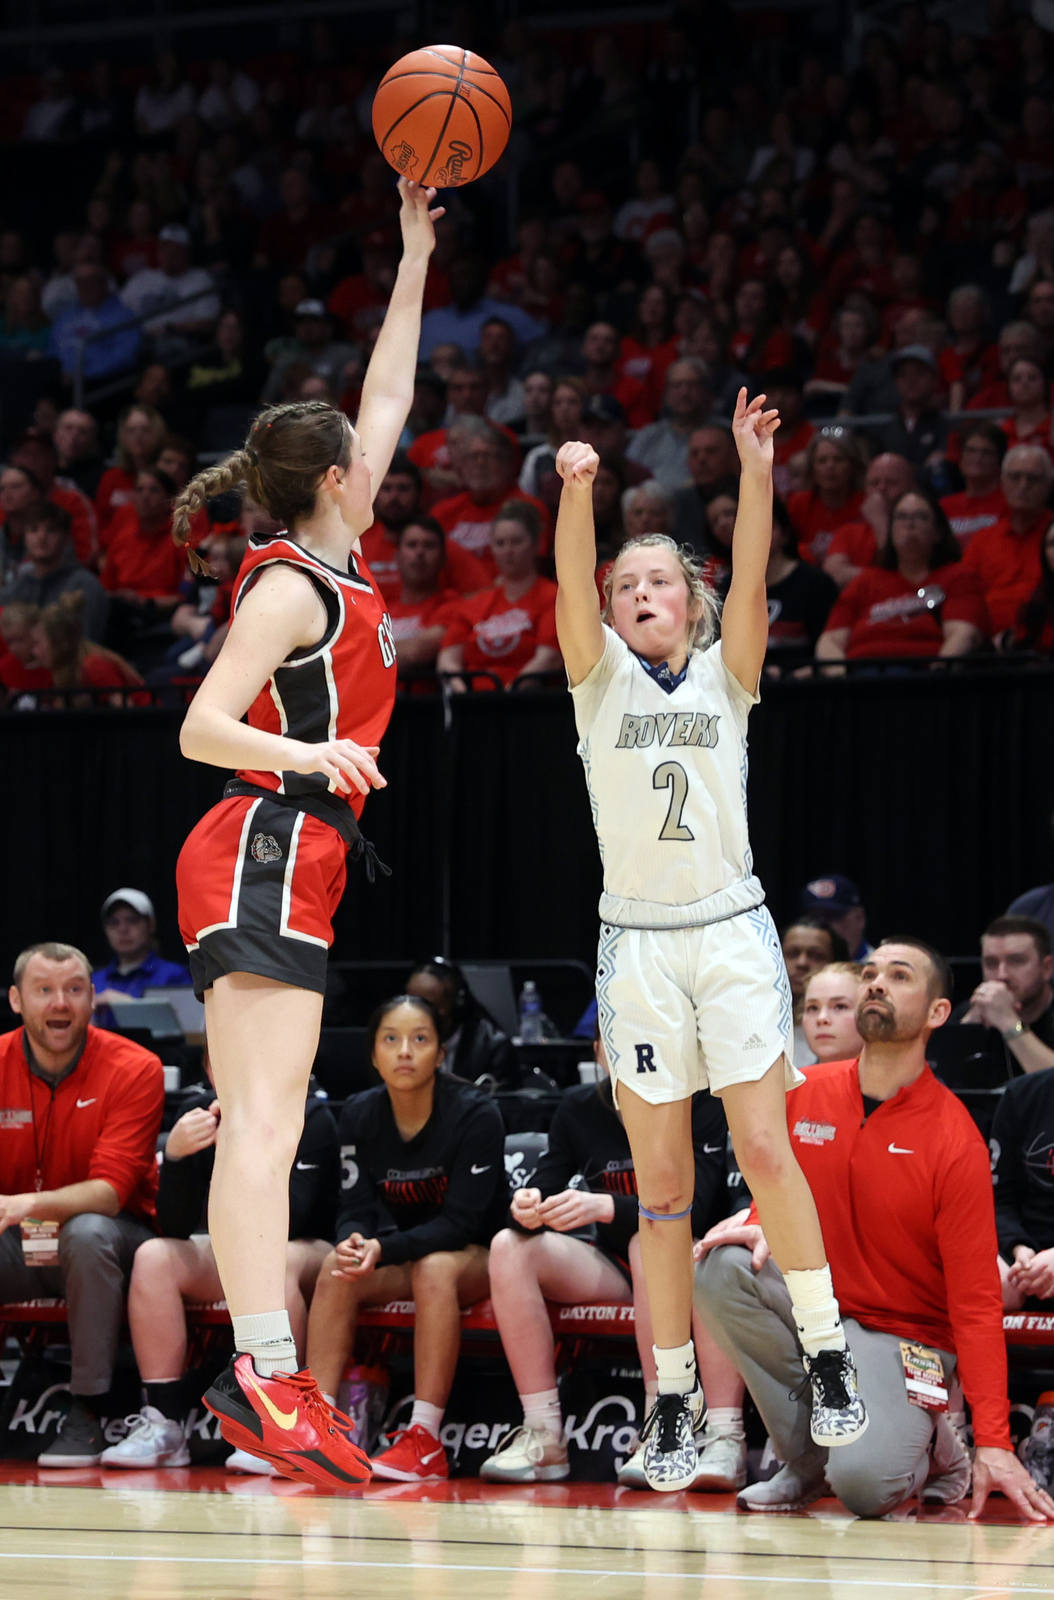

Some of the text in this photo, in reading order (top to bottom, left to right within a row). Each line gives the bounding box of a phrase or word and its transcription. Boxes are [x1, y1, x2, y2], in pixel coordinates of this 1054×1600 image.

[615, 712, 721, 749] ROVERS
[652, 760, 695, 841] 2
[634, 1043, 657, 1074] R
[742, 1041, 767, 1051] adidas
[560, 1306, 618, 1320] DAYTON
